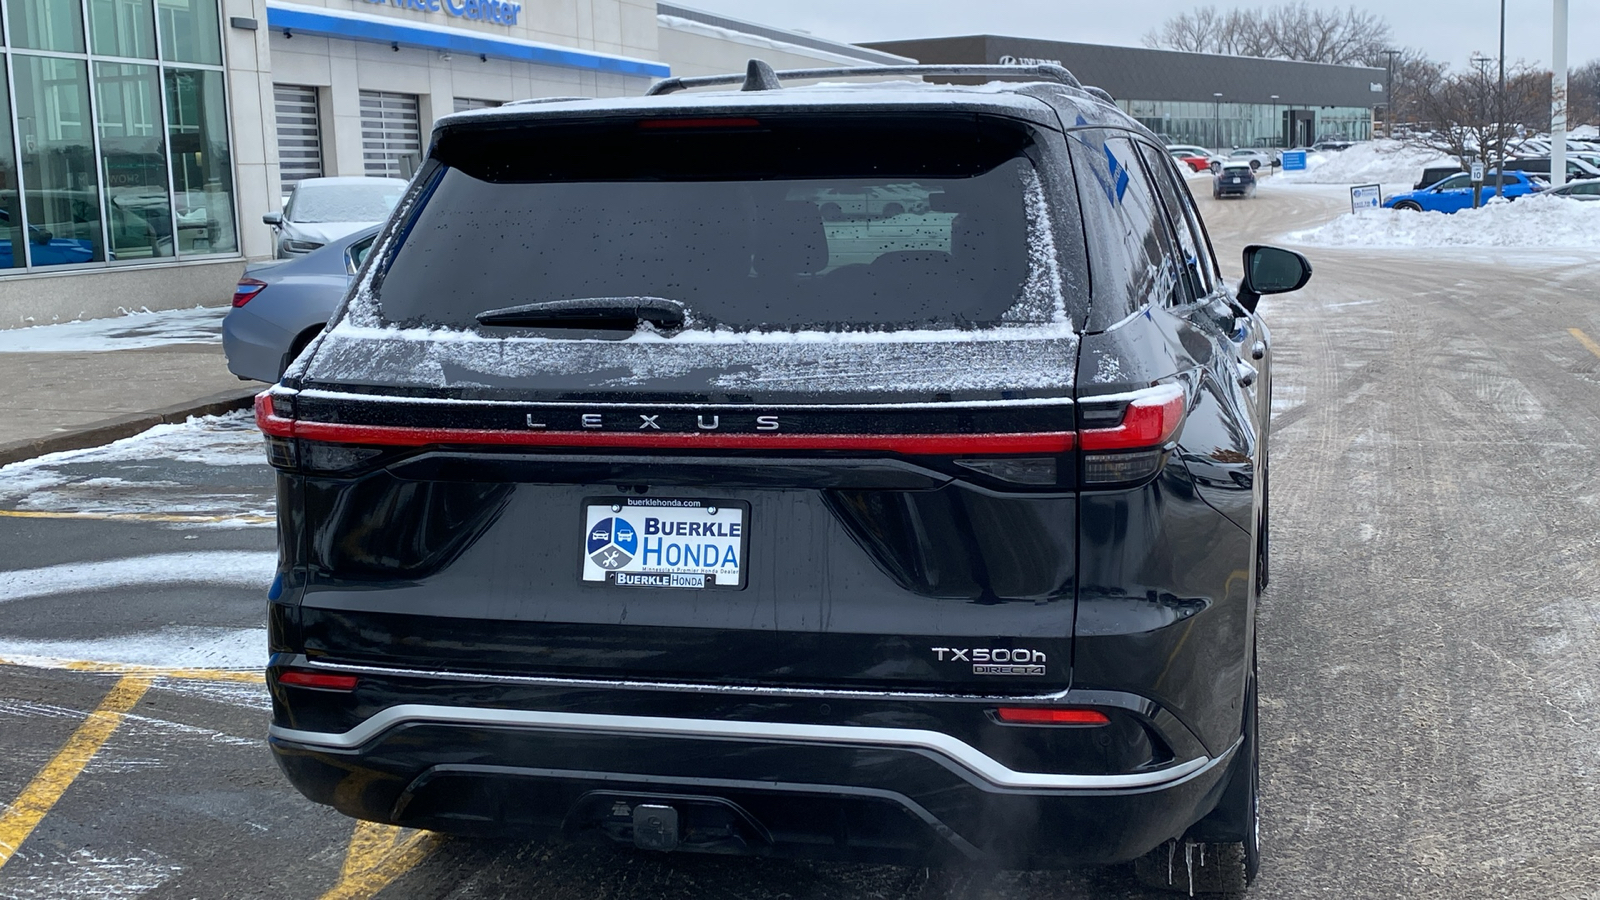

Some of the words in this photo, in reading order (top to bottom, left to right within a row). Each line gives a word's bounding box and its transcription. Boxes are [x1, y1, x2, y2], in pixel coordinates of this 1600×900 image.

[446, 0, 521, 26] Center
[1473, 171, 1482, 179] 10
[526, 413, 780, 431] LEXUS
[627, 498, 701, 507] buerklehonda.com
[644, 517, 741, 538] BUERKLE
[642, 537, 739, 568] HONDA
